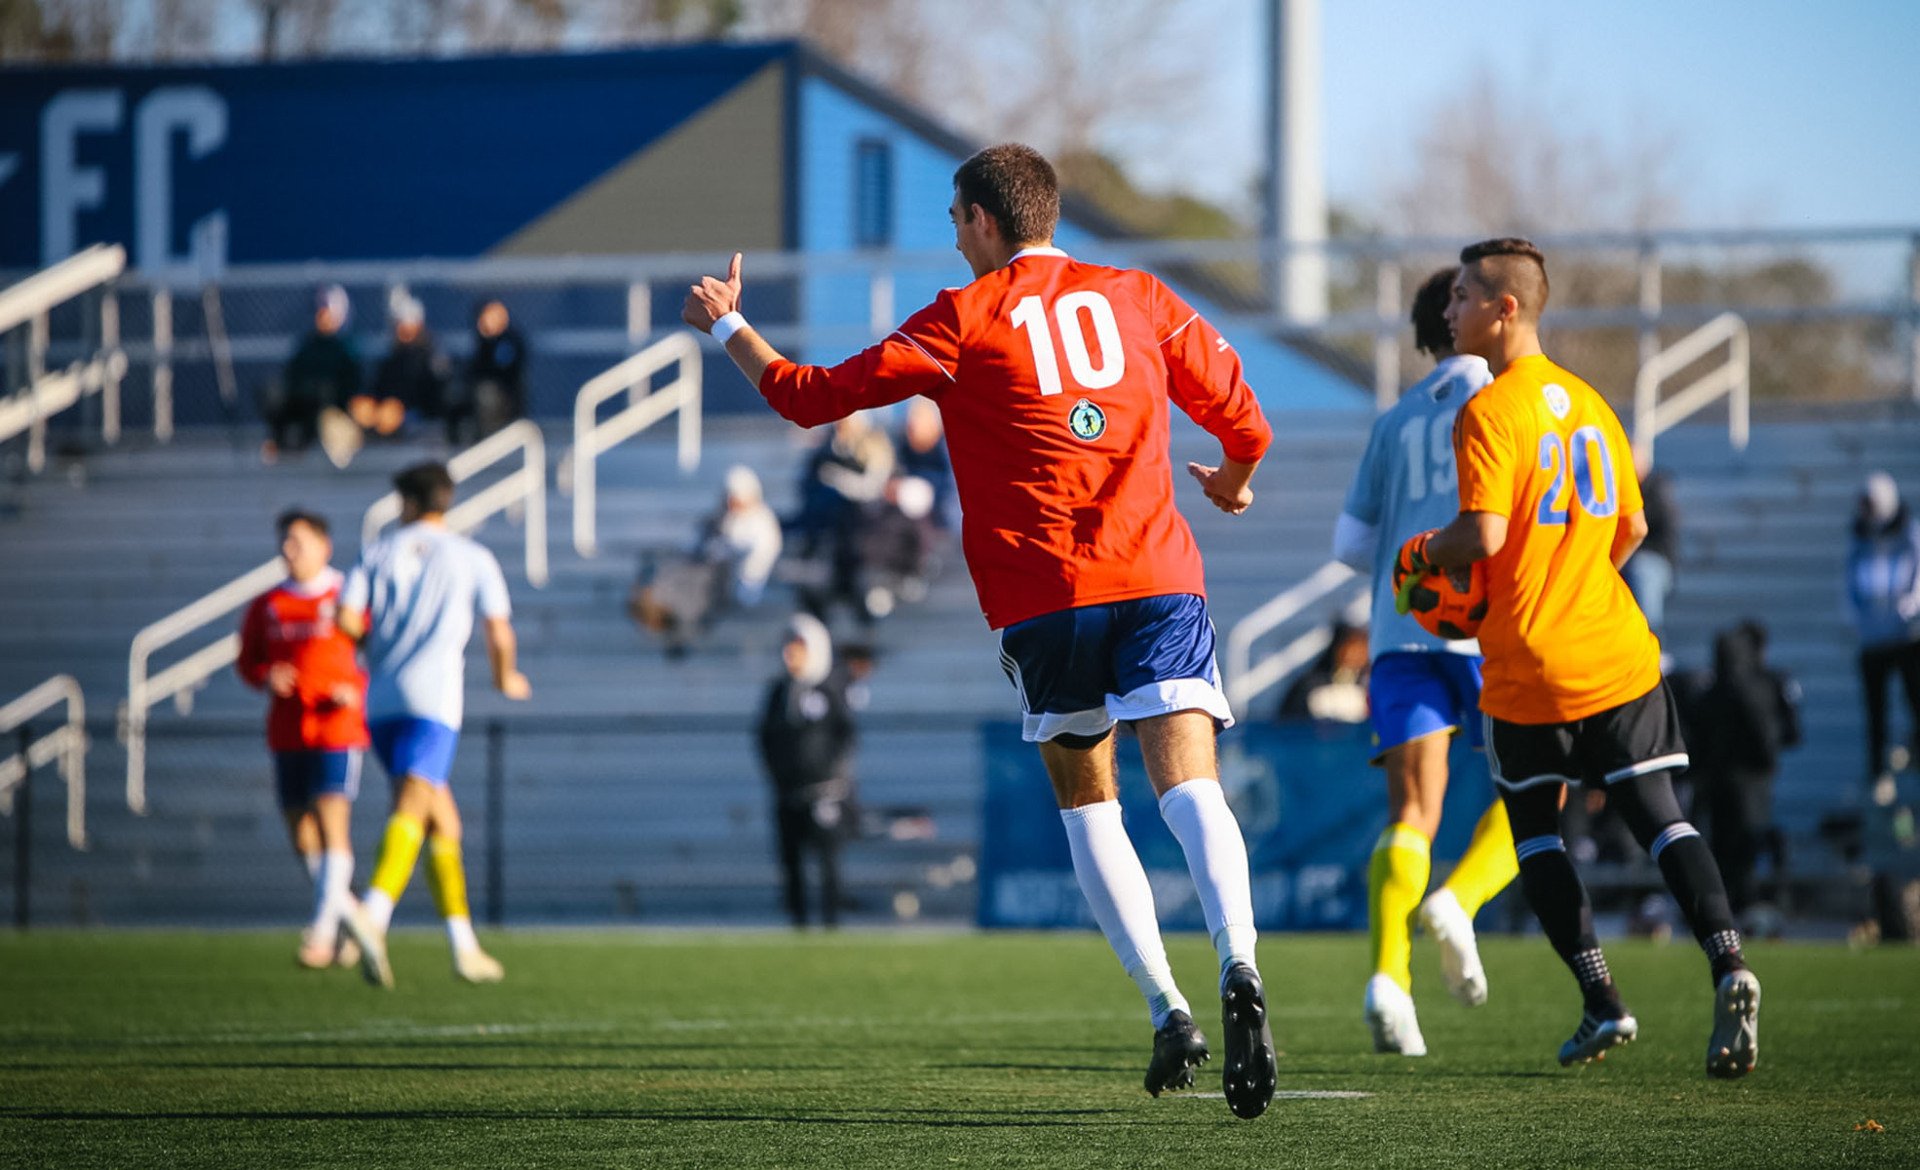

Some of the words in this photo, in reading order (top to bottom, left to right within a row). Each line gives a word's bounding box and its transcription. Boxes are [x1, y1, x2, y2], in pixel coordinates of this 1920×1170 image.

[41, 87, 229, 284] FC
[1010, 290, 1125, 396] 10
[1401, 408, 1459, 499] 19
[1537, 425, 1617, 525] 20
